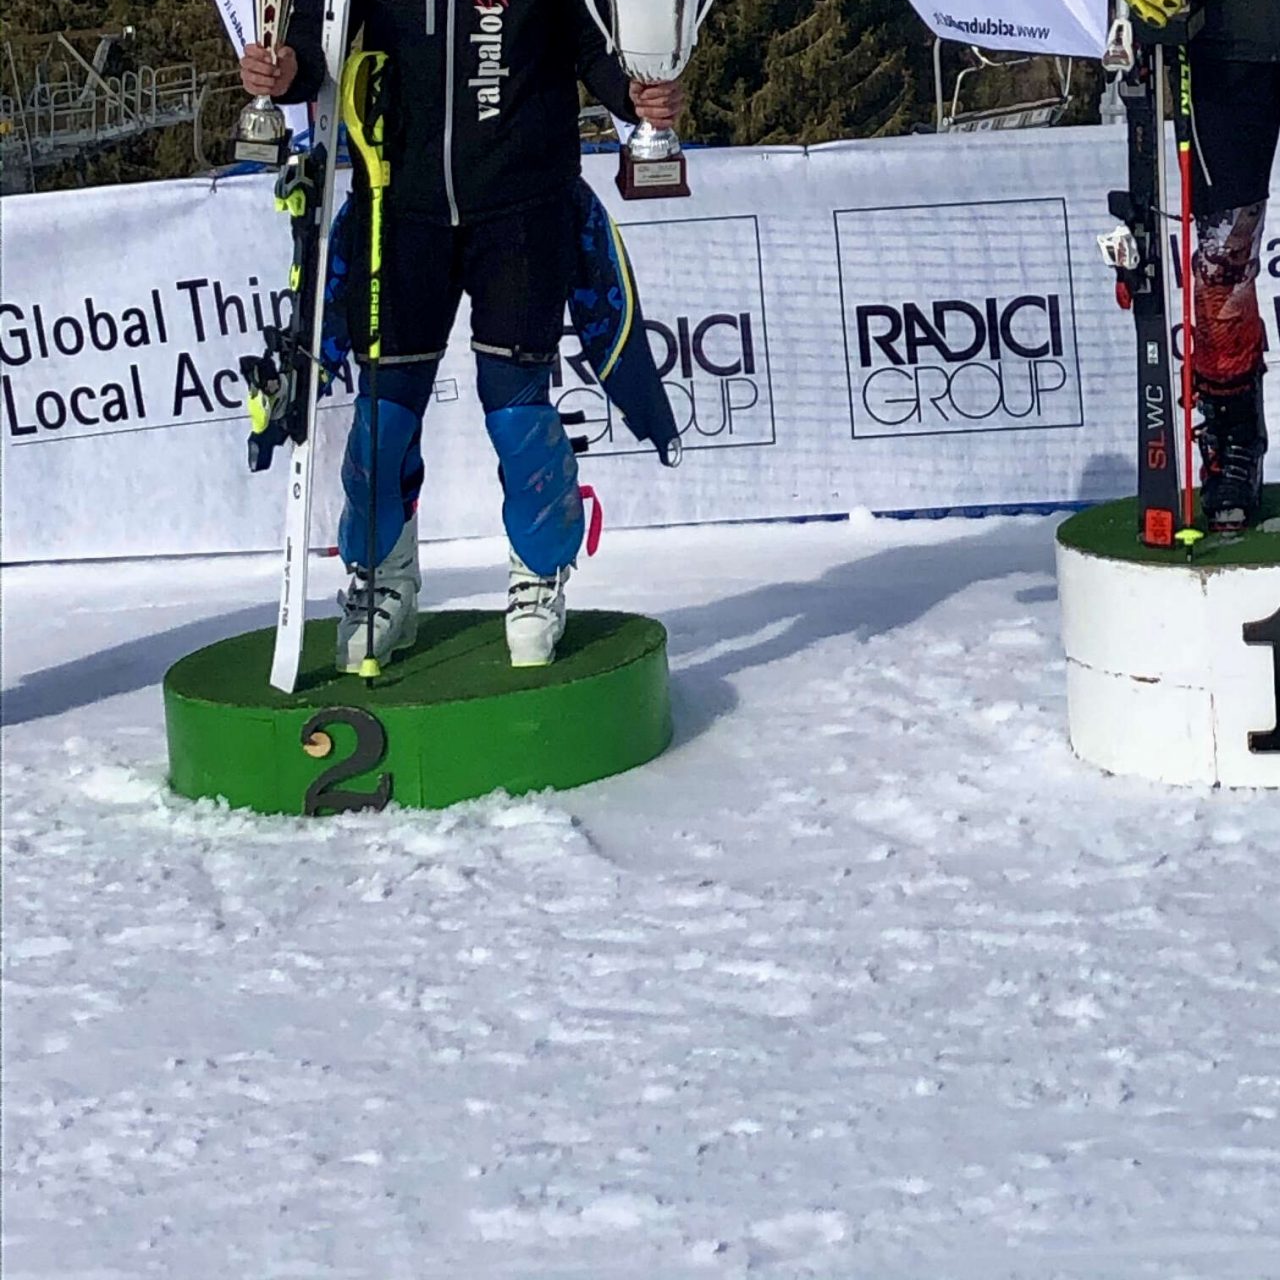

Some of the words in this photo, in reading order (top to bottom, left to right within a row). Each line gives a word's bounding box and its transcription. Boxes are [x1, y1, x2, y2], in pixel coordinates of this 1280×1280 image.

[0, 288, 168, 367] Global
[856, 294, 1064, 368] RADICI
[2, 364, 146, 437] Local
[862, 359, 1067, 426] GROUP
[301, 706, 394, 817] 2
